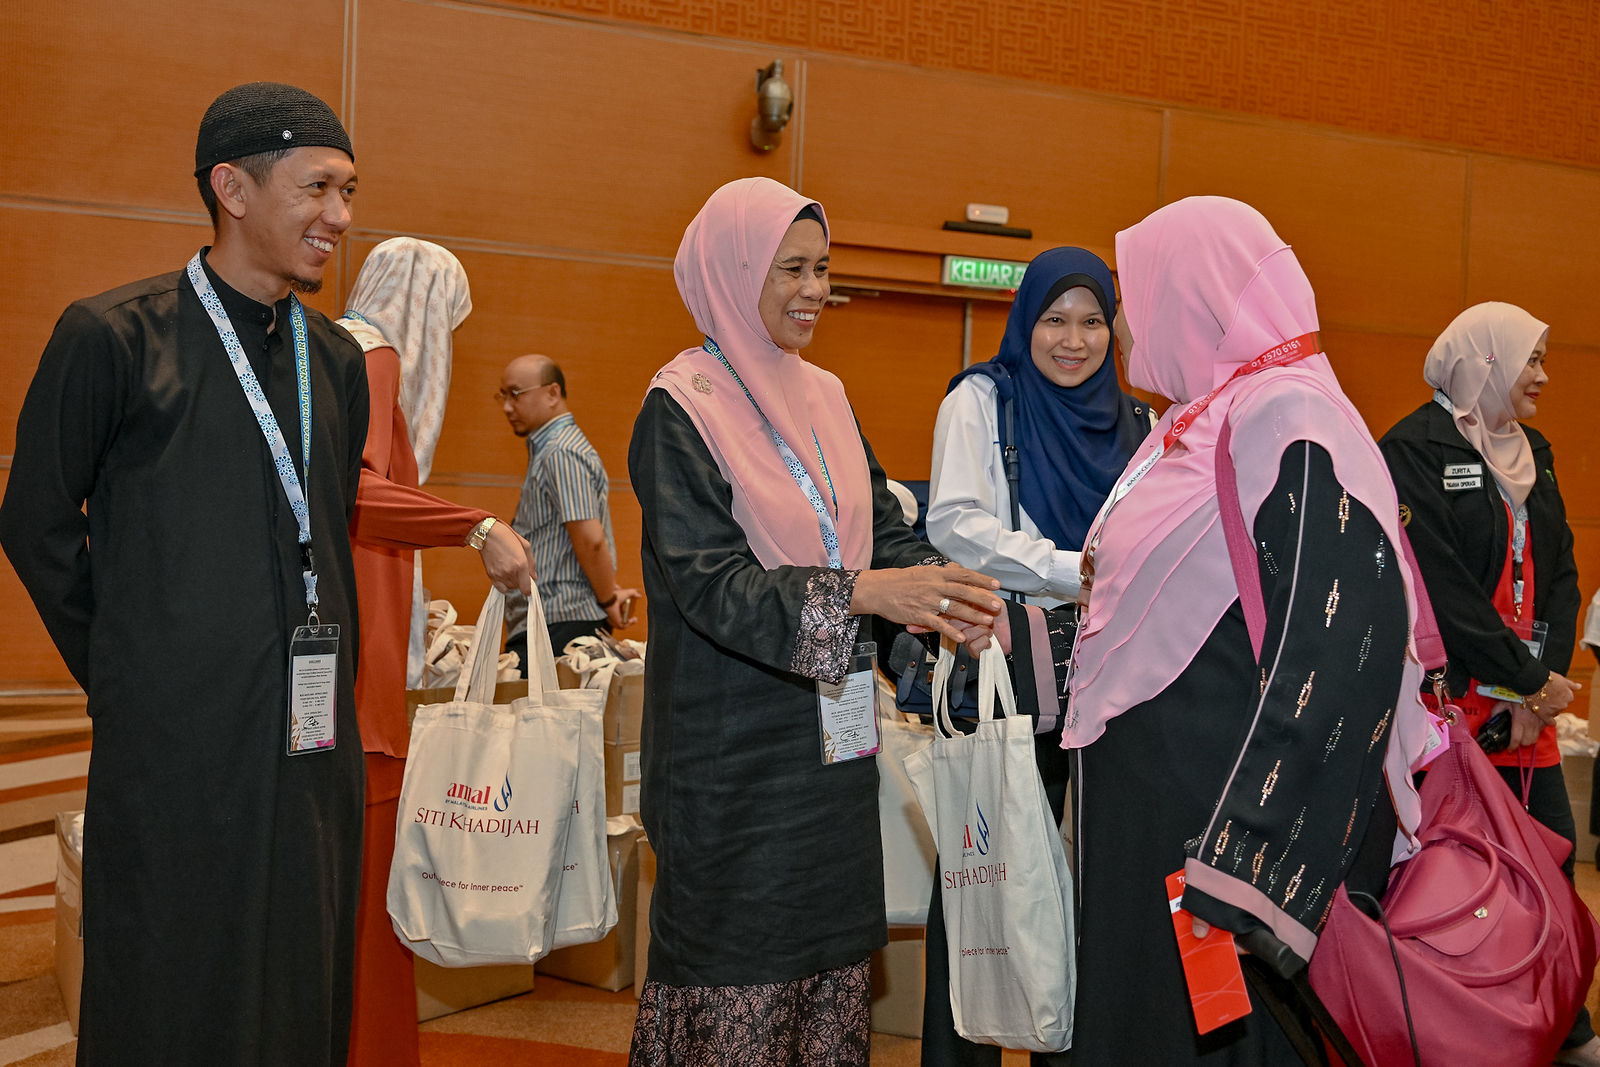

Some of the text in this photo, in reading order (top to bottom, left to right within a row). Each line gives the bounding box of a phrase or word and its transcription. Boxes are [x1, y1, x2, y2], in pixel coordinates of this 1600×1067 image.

[951, 260, 1013, 285] KELUAR
[292, 313, 306, 341] 1445H
[297, 341, 307, 359] AIR
[1262, 348, 1282, 362] 2570
[1282, 340, 1301, 353] 6161
[299, 359, 309, 393] TANAH
[302, 394, 310, 418] HAJI
[447, 783, 490, 804] amal
[414, 807, 540, 838] SITI KHADIJAH
[458, 881, 469, 890] for
[470, 883, 490, 891] inner
[962, 862, 1007, 888] HADIJAH
